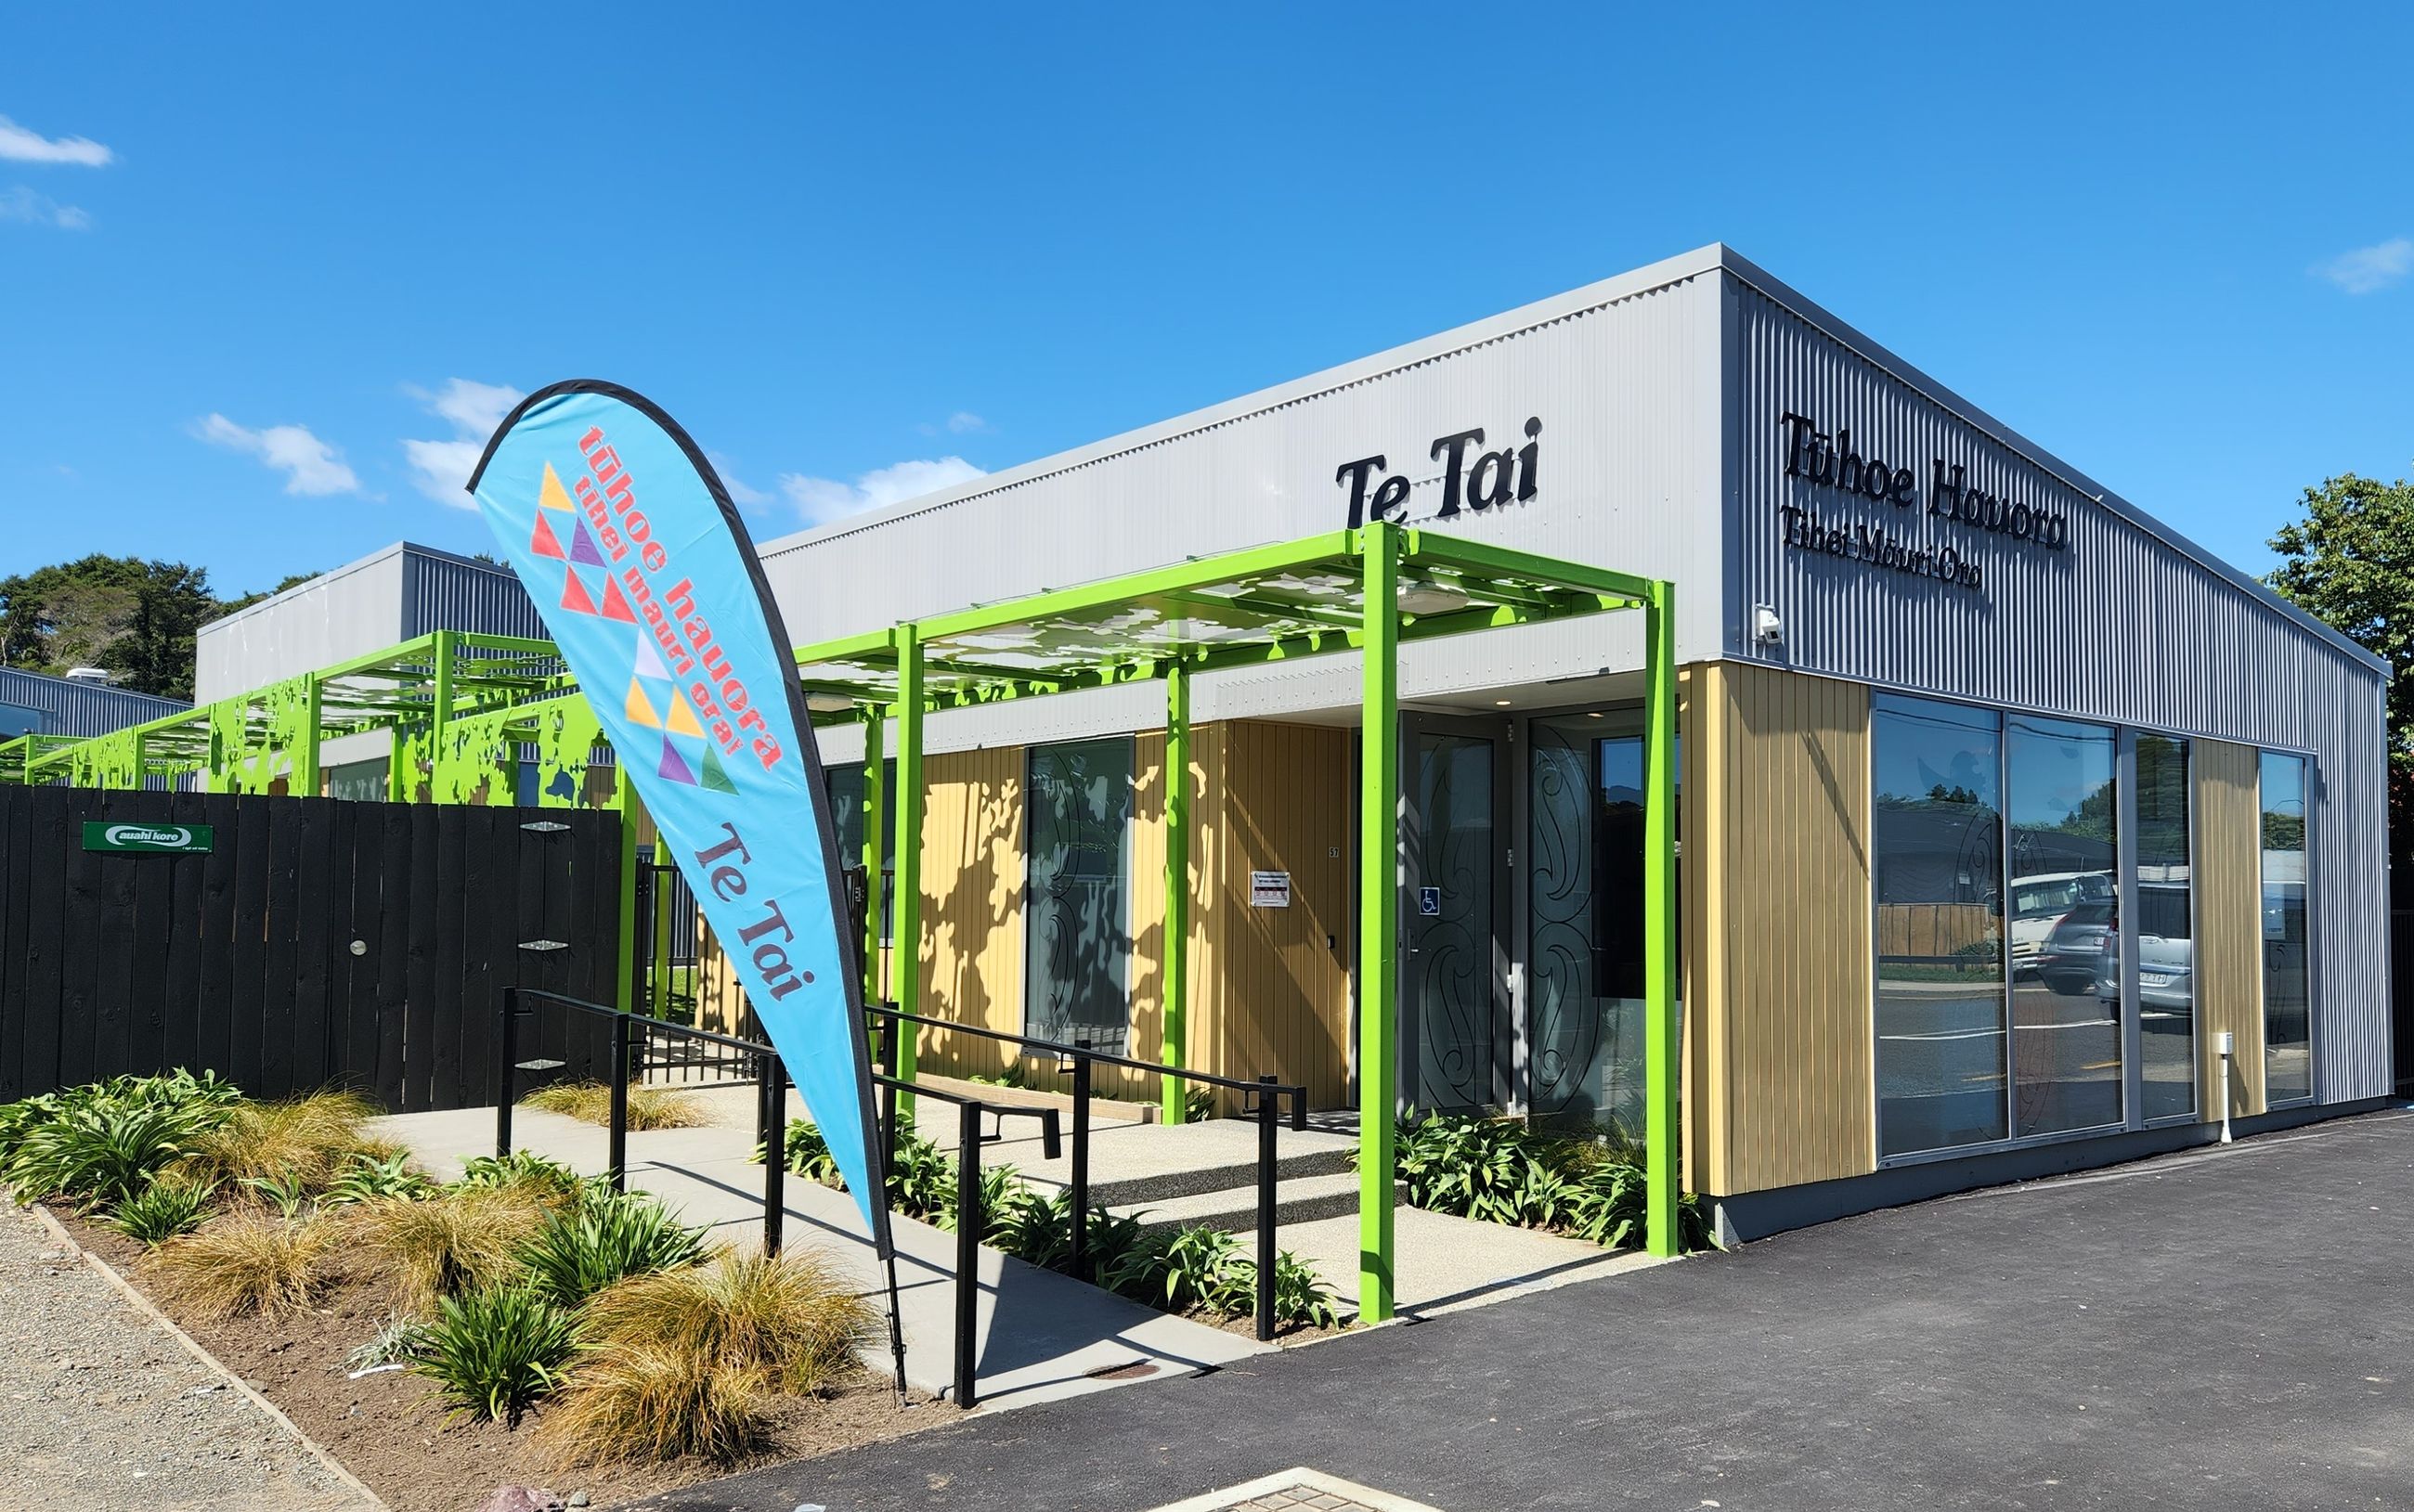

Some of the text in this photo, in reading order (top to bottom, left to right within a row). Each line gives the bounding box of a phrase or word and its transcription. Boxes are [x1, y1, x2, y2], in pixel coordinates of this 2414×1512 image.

[1335, 416, 1542, 529] Te Tai
[1780, 410, 2069, 550] Tūhoe Hauora
[578, 426, 783, 772] tūhoe hauora
[1778, 504, 1849, 557] Tihei
[1937, 546, 1982, 589] Ora
[621, 564, 694, 676] mauri
[118, 831, 179, 841] auahi kore
[694, 821, 815, 1002] Te Tai
